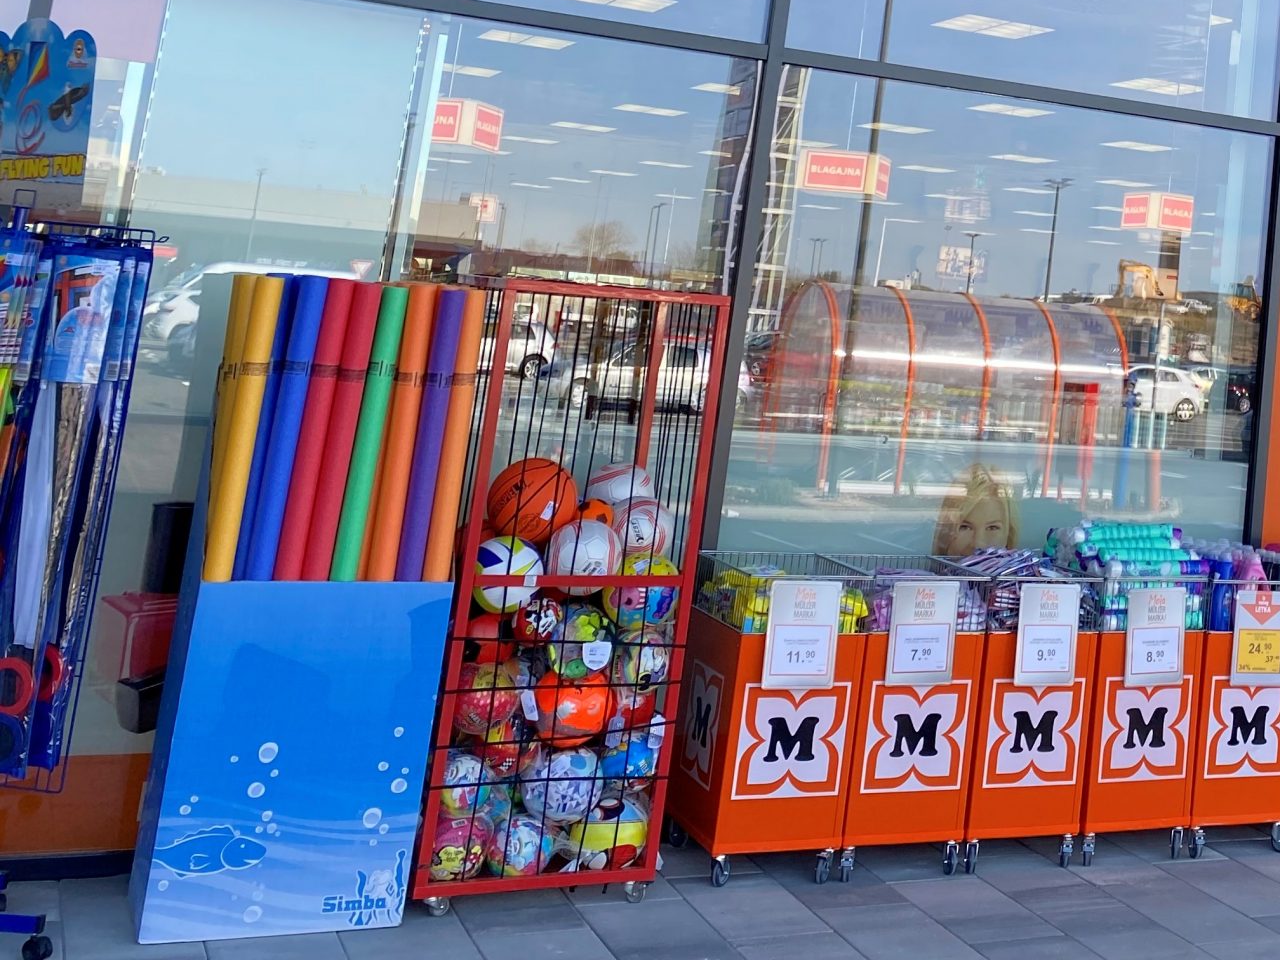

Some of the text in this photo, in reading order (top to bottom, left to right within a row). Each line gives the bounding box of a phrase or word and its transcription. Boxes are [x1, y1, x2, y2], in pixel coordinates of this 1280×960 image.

[0, 154, 85, 180] FLYING FUN
[810, 164, 861, 176] BLAGAJNA
[763, 716, 819, 762] M
[890, 712, 942, 758] M
[1010, 709, 1059, 754] M
[1123, 706, 1169, 749] M
[1227, 705, 1270, 746] M
[322, 894, 387, 913] Simba
